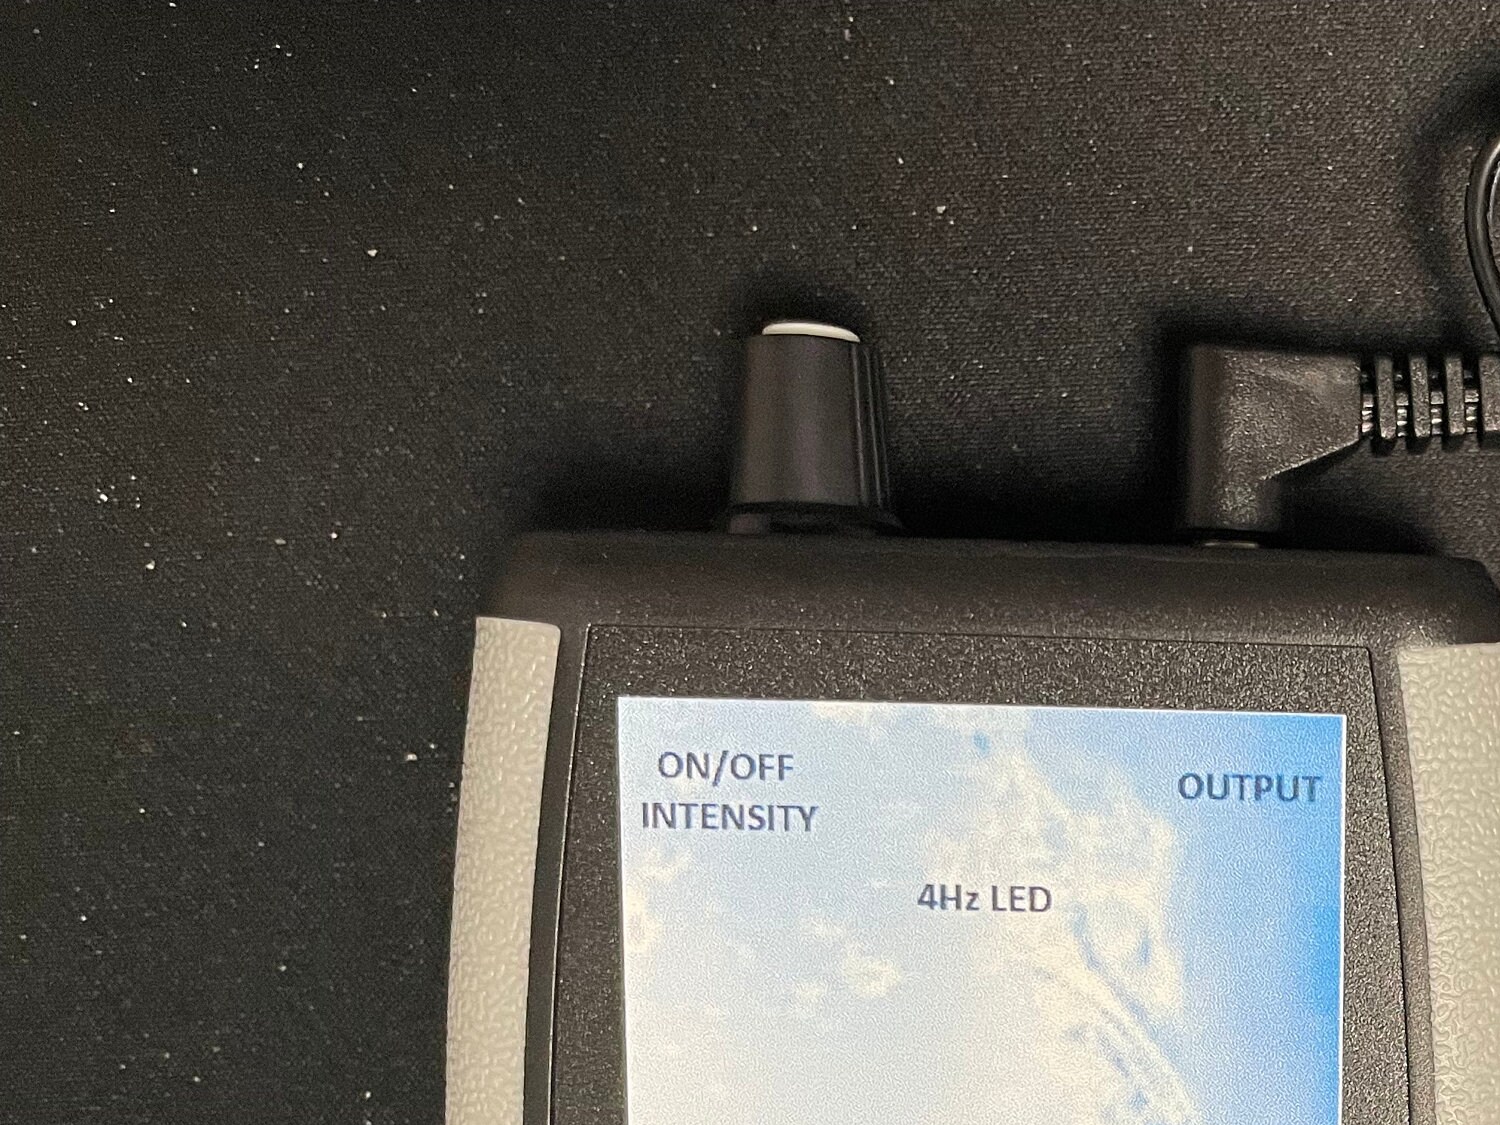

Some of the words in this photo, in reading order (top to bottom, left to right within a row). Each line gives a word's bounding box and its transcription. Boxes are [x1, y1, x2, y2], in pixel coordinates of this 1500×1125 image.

[657, 749, 794, 788] ON/OFF
[1177, 772, 1321, 803] OUTPUT
[641, 802, 818, 832] INTENSITY
[917, 883, 980, 912] 4Hz
[991, 885, 1052, 913] LED
